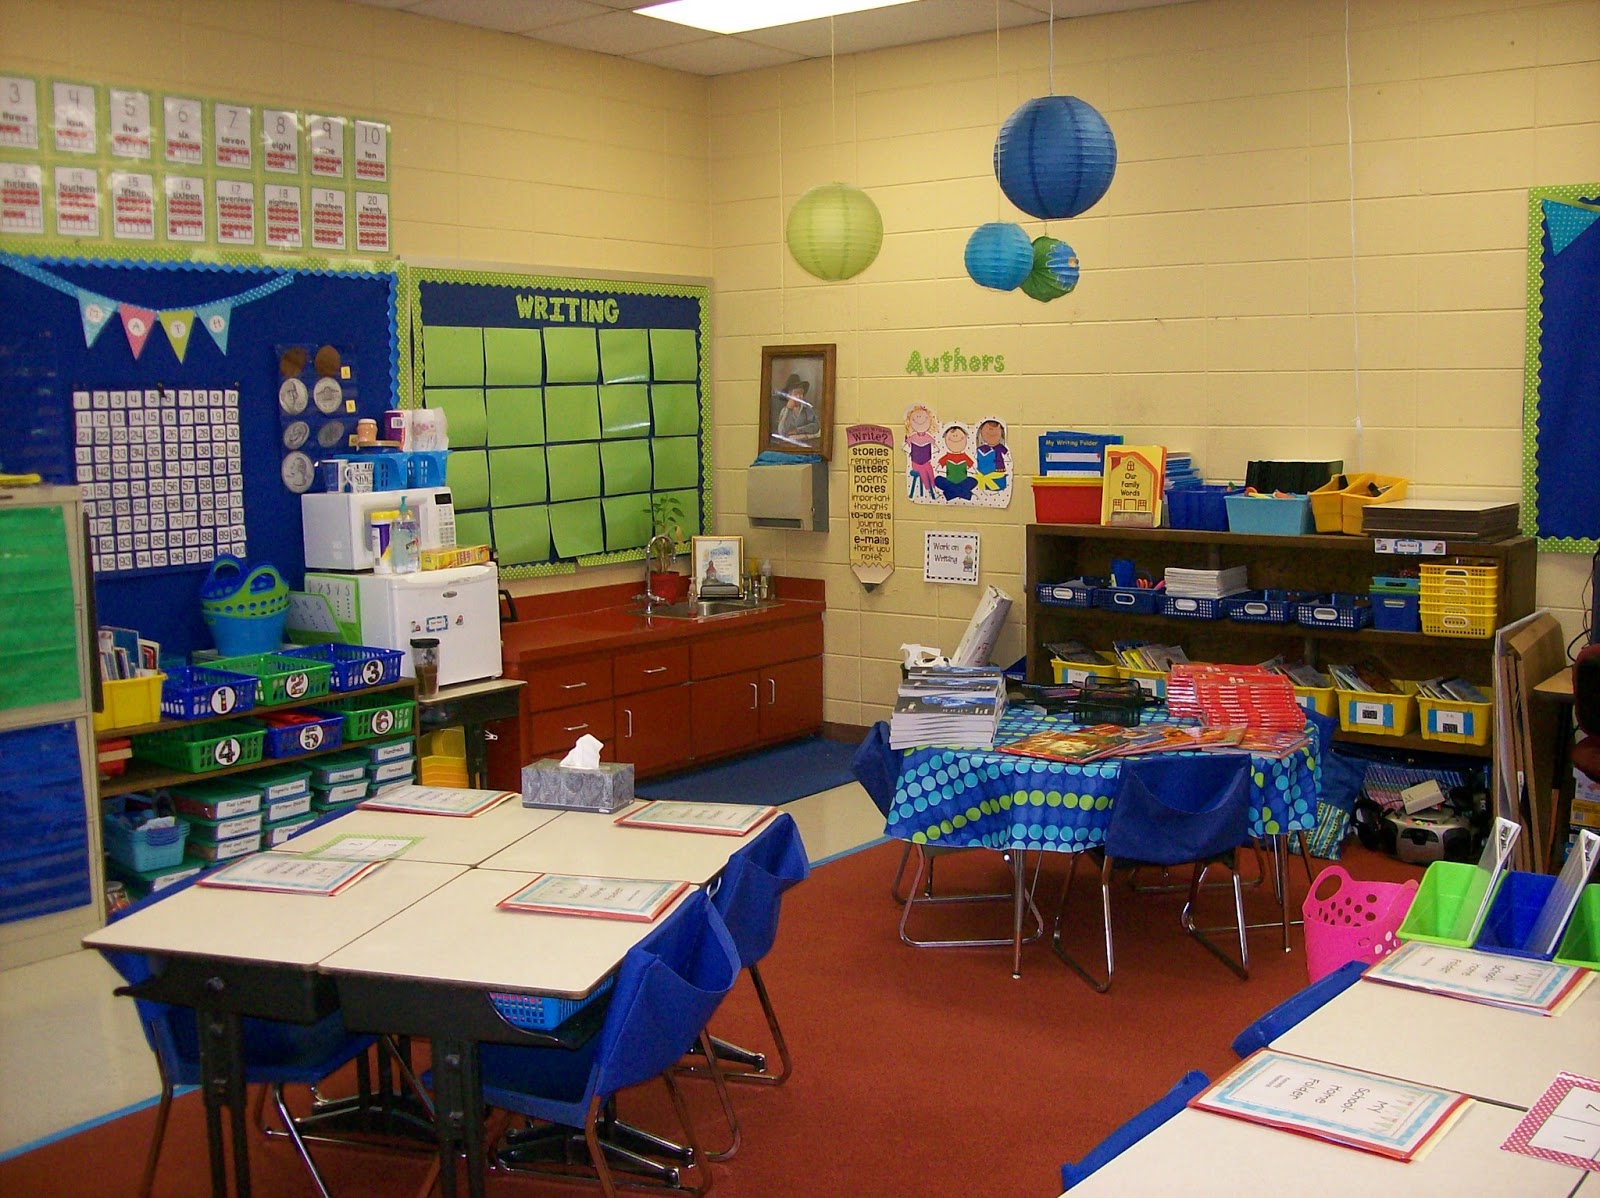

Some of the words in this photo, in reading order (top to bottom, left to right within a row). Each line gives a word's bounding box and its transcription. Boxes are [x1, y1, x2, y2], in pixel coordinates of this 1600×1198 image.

[9, 83, 20, 103] 3
[69, 90, 80, 109] 4
[126, 98, 135, 116] 5
[3, 112, 28, 122] three
[179, 106, 187, 123] 6
[229, 110, 238, 129] 7
[123, 124, 139, 133] five
[277, 117, 285, 134] 8
[323, 122, 332, 140] 9
[179, 131, 189, 139] six
[221, 137, 245, 145] seven
[363, 128, 380, 145] 10
[272, 142, 291, 151] eight
[365, 151, 376, 159] ten
[128, 177, 138, 187] 15
[181, 180, 190, 190] 16
[174, 191, 199, 199] sixteen
[232, 185, 240, 194] 17
[279, 189, 288, 198] 18
[269, 199, 297, 207] eighteen
[326, 193, 334, 201] 19
[368, 196, 377, 204] 20
[315, 202, 342, 210] nineteen
[515, 294, 620, 324] WRITING
[906, 347, 1004, 376] Authors
[79, 397, 83, 405] 1
[98, 397, 104, 405] 2
[115, 396, 121, 405] 3
[131, 395, 137, 403] 4
[150, 394, 155, 402] 5
[166, 393, 171, 401] 6
[183, 394, 188, 402] 7
[198, 393, 203, 402] 8
[213, 394, 218, 402] 9
[228, 393, 236, 402] 10
[80, 415, 88, 423] 11
[96, 415, 105, 423] 12
[113, 414, 122, 422] 13
[148, 412, 156, 420] 15
[165, 412, 173, 420] 16
[182, 413, 190, 422] 17
[197, 412, 205, 420] 18
[212, 412, 221, 421] 19
[227, 410, 237, 419] 20
[79, 432, 89, 441] 21
[96, 431, 108, 441] 22
[114, 431, 125, 440] 23
[131, 430, 142, 439] 24
[148, 430, 158, 439] 25
[166, 431, 176, 439] 26
[182, 430, 192, 439] 27
[198, 429, 208, 438] 28
[214, 428, 224, 437] 29
[229, 428, 238, 436] 30
[852, 432, 888, 443] Write?
[854, 475, 888, 484] poems
[82, 487, 92, 496] 51
[97, 486, 108, 496] 52
[114, 485, 126, 494] 53
[133, 484, 144, 493] 54
[151, 482, 163, 492] 55
[167, 482, 178, 491] 56
[183, 481, 193, 490] 57
[200, 480, 210, 489] 58
[216, 479, 226, 488] 59
[232, 479, 242, 488] 60
[857, 485, 885, 493] notes
[852, 493, 890, 502] important
[100, 504, 112, 513] 62
[117, 503, 128, 512] 63
[134, 502, 146, 511] 64
[152, 500, 163, 510] 65
[168, 500, 179, 509] 66
[185, 499, 195, 508] 67
[202, 498, 212, 507] 68
[217, 497, 227, 506] 69
[231, 496, 241, 505] 70
[854, 503, 888, 513] thoughts
[100, 522, 111, 532] 72
[119, 520, 130, 530] 73
[135, 519, 146, 528] 74
[153, 517, 164, 527] 75
[171, 516, 181, 525] 76
[185, 515, 195, 524] 77
[203, 514, 212, 523] 78
[218, 514, 227, 522] 79
[232, 512, 242, 520] 80
[857, 519, 883, 529] journal
[101, 540, 112, 550] 82
[120, 538, 131, 547] 83
[135, 537, 146, 546] 84
[153, 536, 164, 545] 85
[170, 534, 181, 544] 86
[187, 533, 197, 542] 87
[202, 532, 212, 541] 88
[219, 531, 229, 540] 89
[232, 529, 242, 538] 90
[854, 536, 889, 545] e-mails
[102, 558, 114, 567] 92
[119, 556, 131, 566] 93
[138, 555, 149, 565] 94
[154, 554, 165, 564] 95
[172, 553, 182, 562] 96
[187, 552, 198, 561] 97
[202, 550, 212, 559] 98
[234, 547, 245, 555] 100
[861, 553, 882, 561] notes
[935, 555, 958, 564] Writing
[365, 662, 381, 681] 3
[290, 674, 305, 696] 2
[217, 689, 227, 711] 1
[376, 711, 389, 731] 6
[305, 727, 319, 748] 5
[218, 739, 235, 762] 4
[1290, 1078, 1320, 1099] Folder
[1315, 1084, 1342, 1104] Home
[1341, 1087, 1370, 1113] School-
